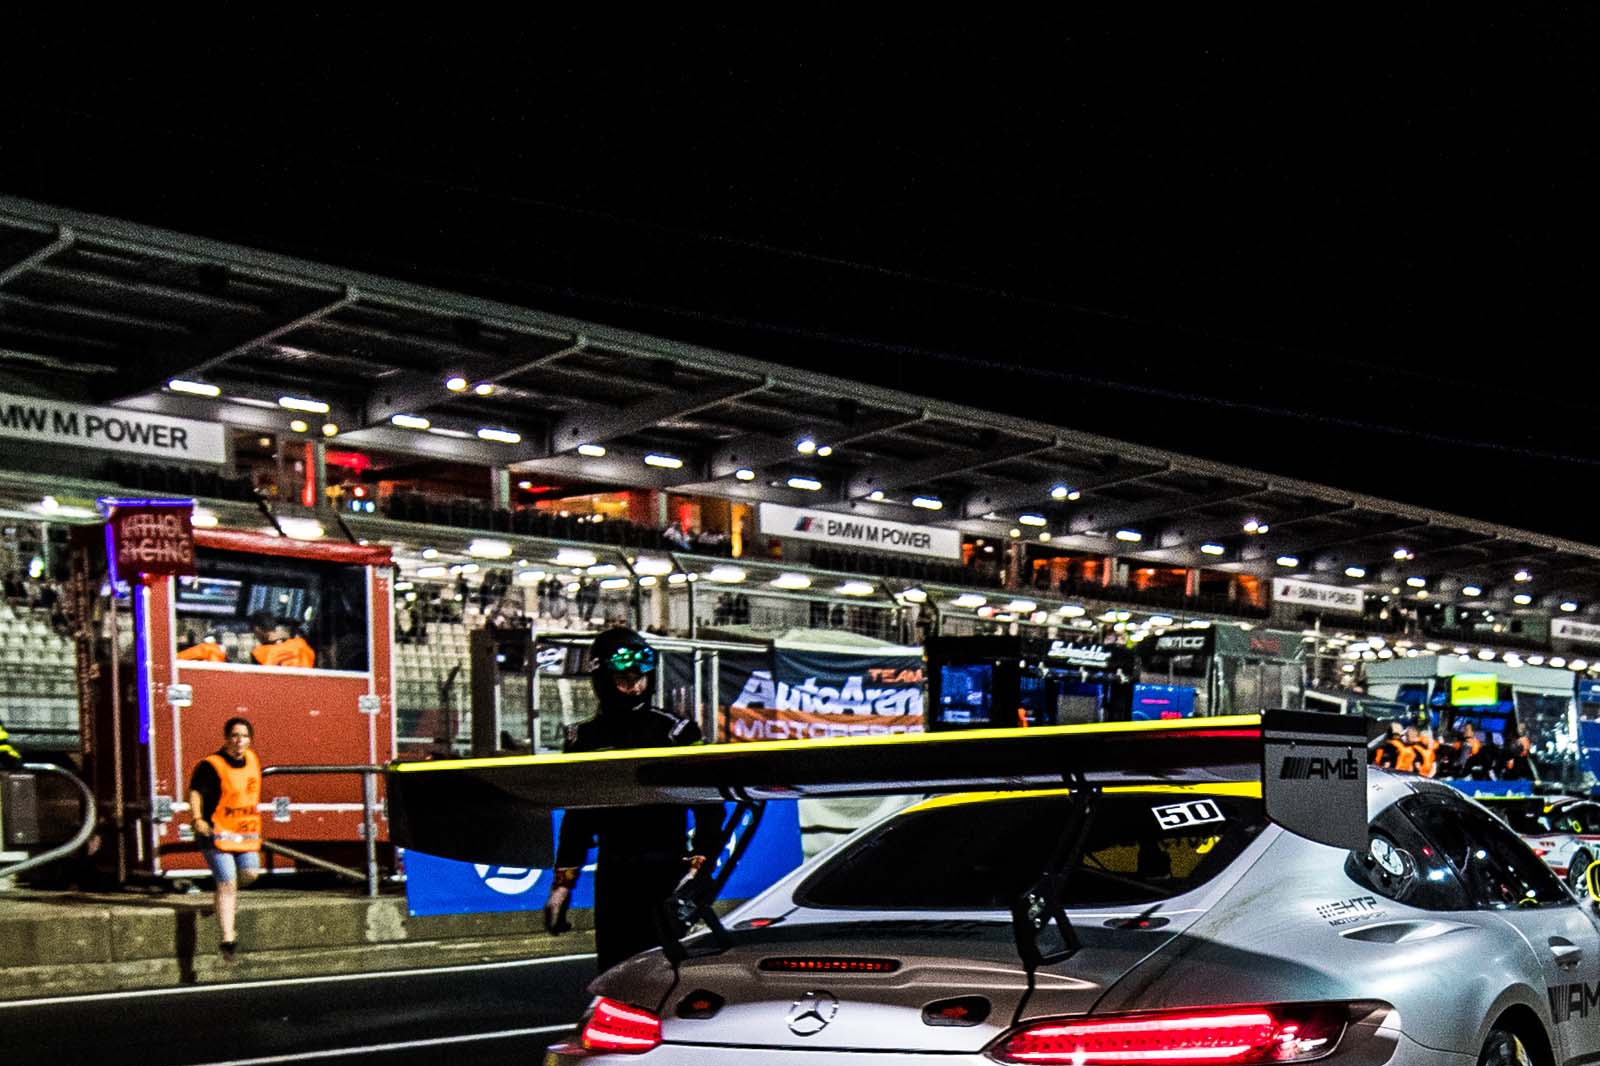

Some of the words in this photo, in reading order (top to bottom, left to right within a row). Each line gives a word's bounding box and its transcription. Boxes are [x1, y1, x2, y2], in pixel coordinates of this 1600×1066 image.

[53, 411, 79, 436] M
[85, 414, 188, 450] POWER
[828, 520, 865, 540] BMW
[881, 528, 932, 549] POWER
[869, 668, 925, 682] TEAM
[1307, 756, 1358, 779] AMG
[1156, 802, 1219, 826] 50
